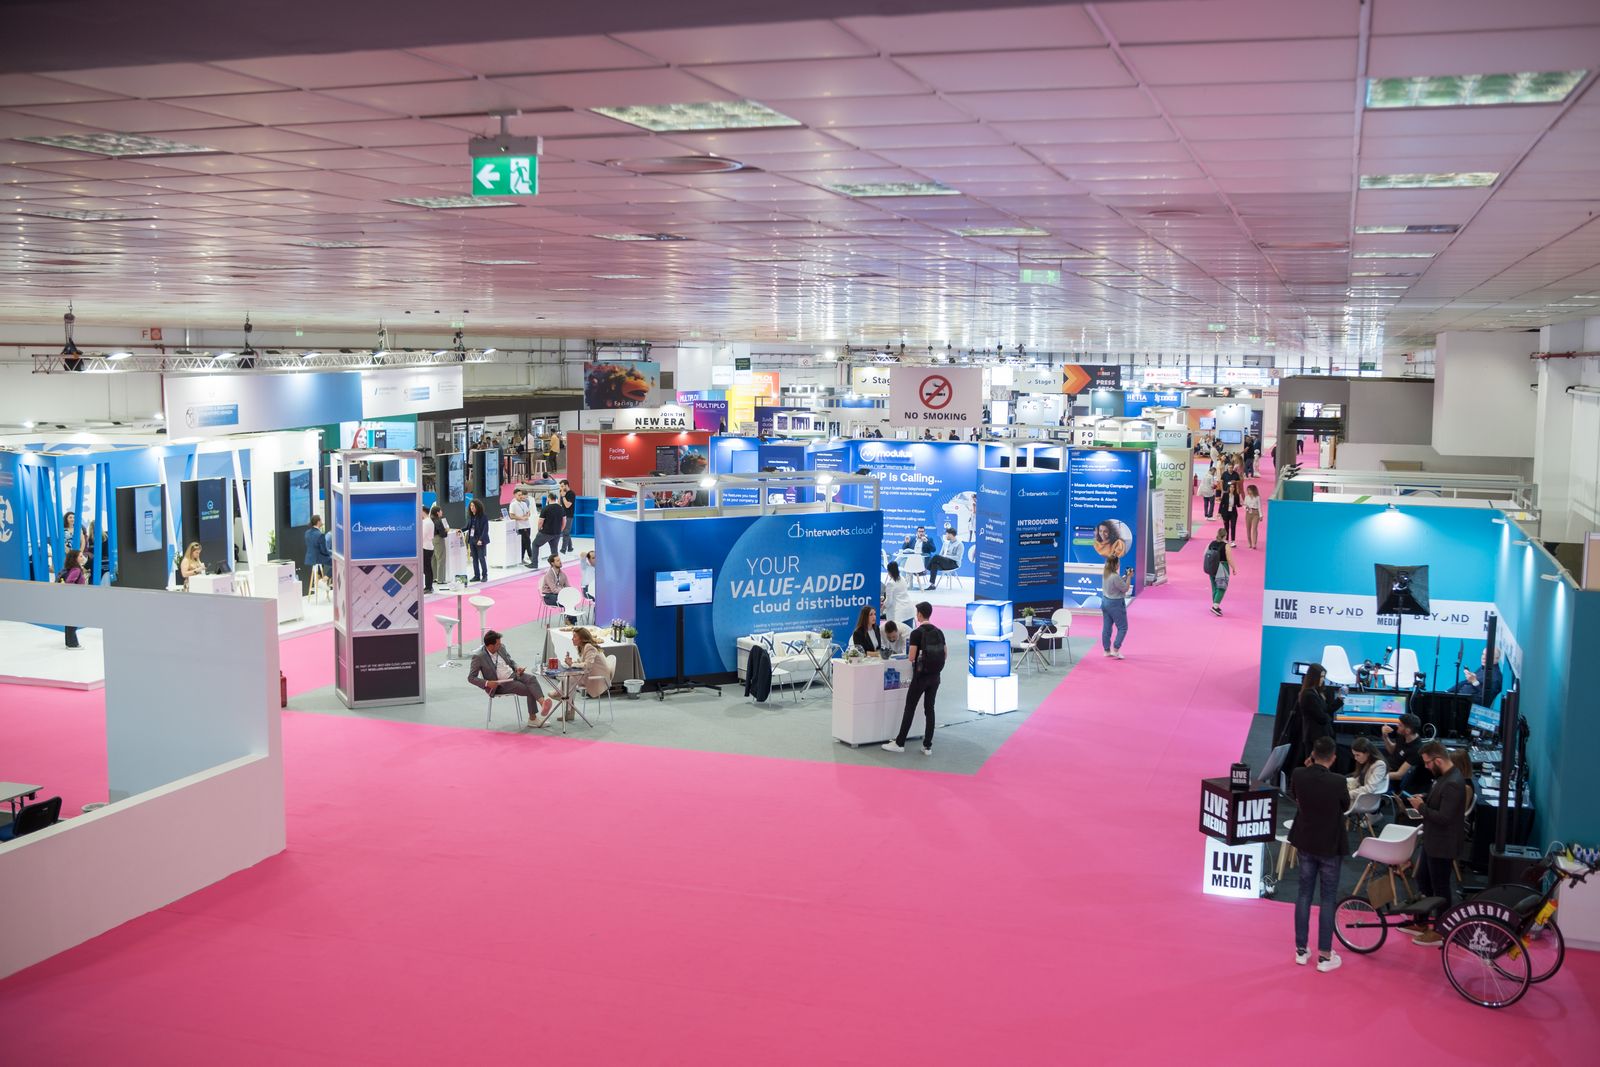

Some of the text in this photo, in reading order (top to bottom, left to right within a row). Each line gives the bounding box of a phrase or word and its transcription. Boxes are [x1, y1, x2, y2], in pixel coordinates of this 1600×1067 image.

[872, 376, 890, 386] Stag
[635, 417, 686, 426] NEW ERA
[904, 411, 967, 421] NO SMOKING
[876, 449, 913, 458] modulus
[1157, 461, 1186, 471] rward
[889, 472, 898, 482] Is
[900, 473, 943, 485] Calling...
[1017, 518, 1059, 526] INTRODUCING
[746, 555, 800, 576] YOUR
[730, 572, 865, 599] VALUE-ADDED
[752, 595, 872, 614] cloud distributor
[1275, 597, 1298, 611] LIVE
[1309, 604, 1364, 617] BEYOND
[1274, 610, 1297, 620] MEDIA
[1232, 770, 1247, 779] LIVE
[1204, 790, 1229, 820] LIVE
[1237, 797, 1272, 822] LIVE
[1203, 812, 1228, 836] MEDIA
[1236, 820, 1271, 838] MEDIA
[1212, 851, 1253, 875] LIVE
[1211, 874, 1252, 890] MEDIA
[1442, 903, 1510, 931] LIVEMEDIA
